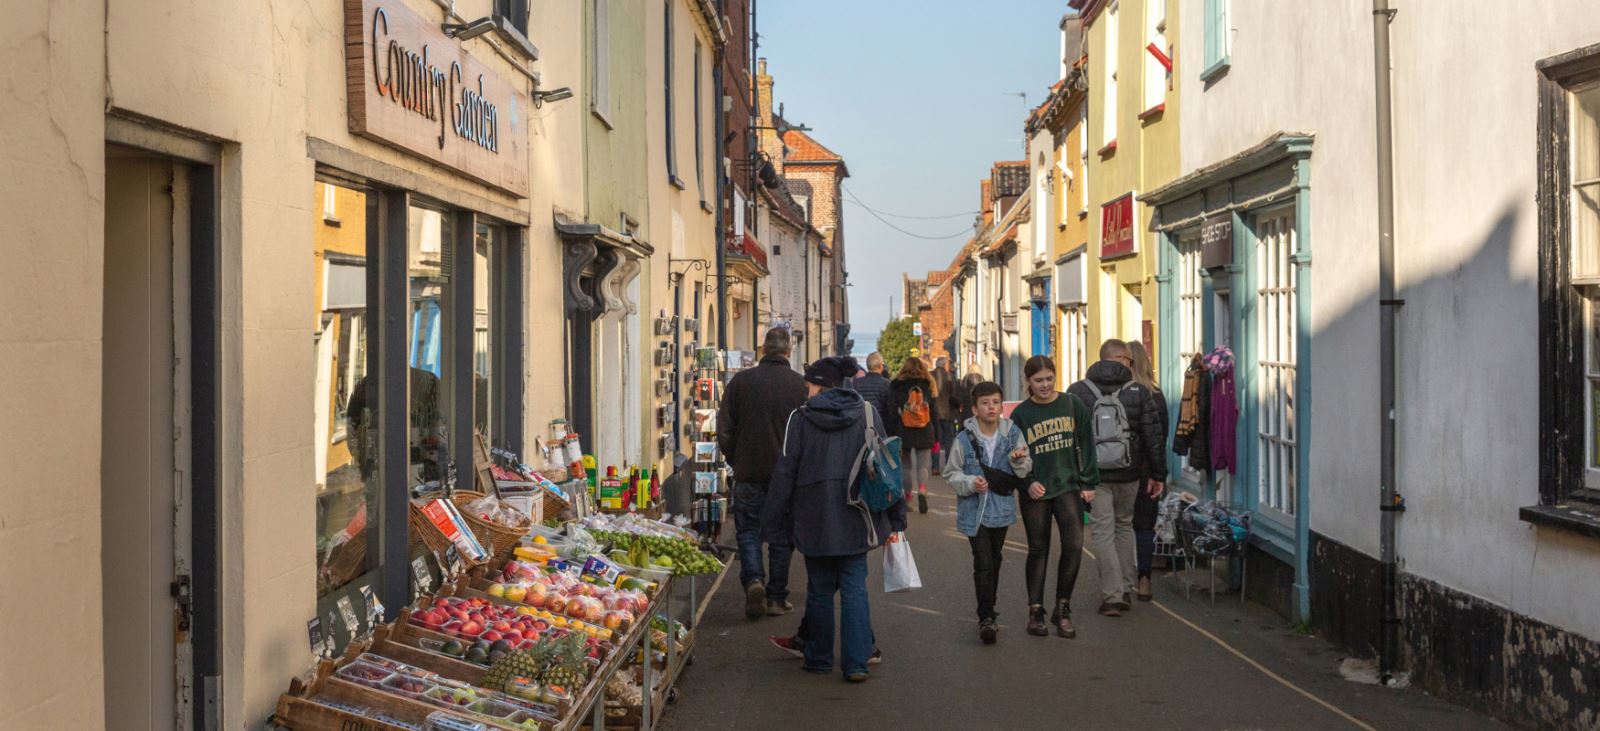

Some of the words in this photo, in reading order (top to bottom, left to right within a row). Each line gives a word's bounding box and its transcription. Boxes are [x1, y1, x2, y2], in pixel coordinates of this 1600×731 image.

[373, 6, 447, 150] Country
[450, 61, 498, 154] Garden
[1202, 224, 1215, 245] SHOE
[1215, 221, 1231, 241] STOP
